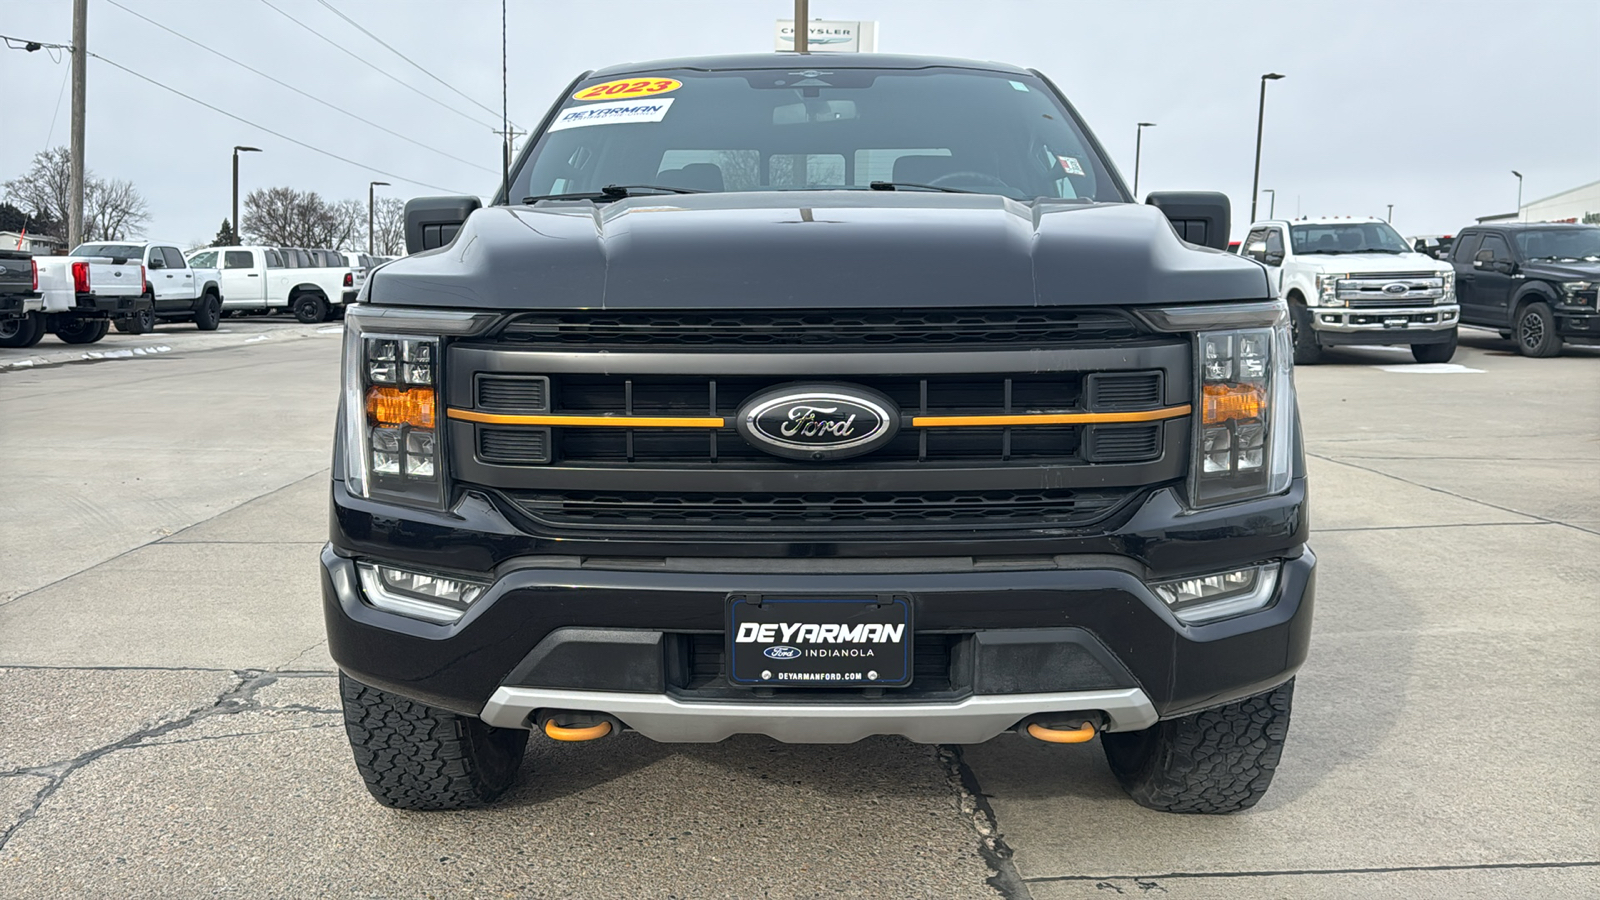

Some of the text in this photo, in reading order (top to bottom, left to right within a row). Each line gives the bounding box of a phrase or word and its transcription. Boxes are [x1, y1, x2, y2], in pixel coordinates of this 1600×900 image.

[581, 80, 667, 98] 2023
[562, 105, 663, 121] DEYARMAN
[780, 405, 856, 437] Ford
[735, 622, 905, 644] DEYARMAN
[771, 647, 874, 657] Ford INDIANOLA
[778, 673, 862, 681] DEYARMANFORD.COM
